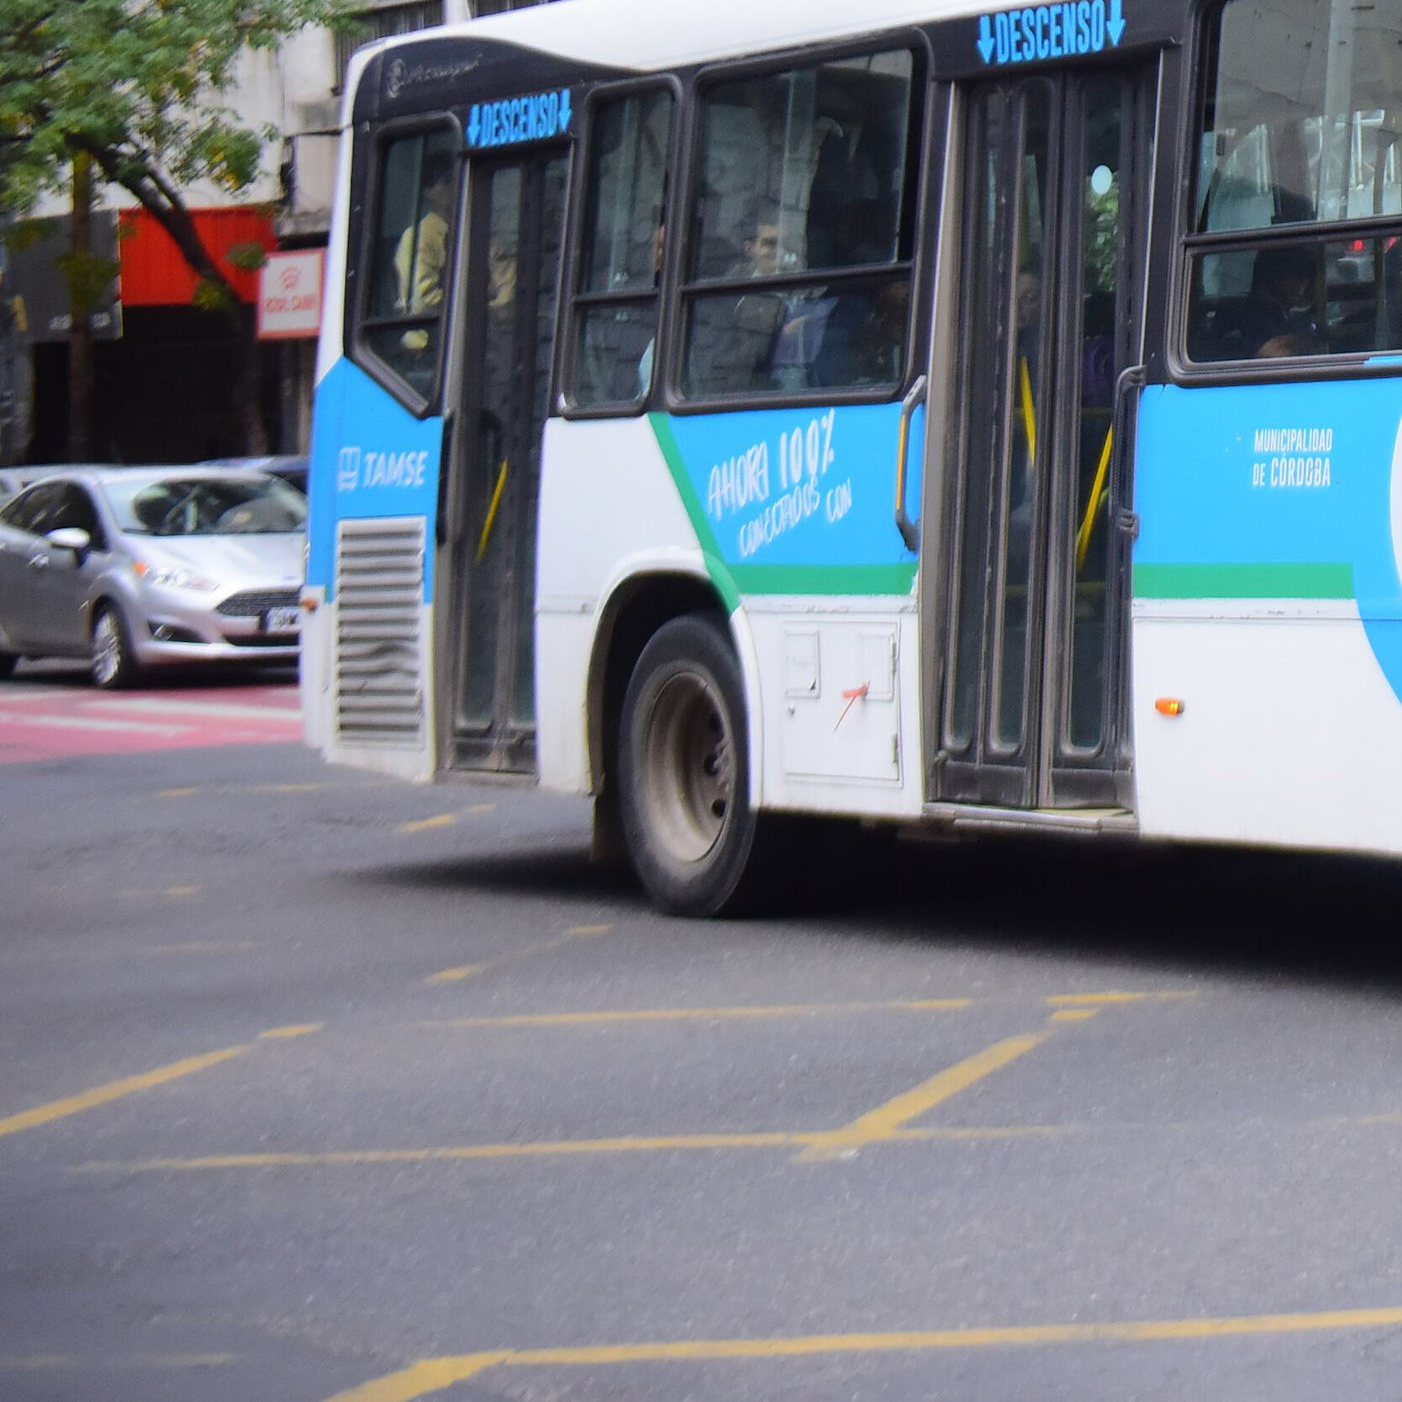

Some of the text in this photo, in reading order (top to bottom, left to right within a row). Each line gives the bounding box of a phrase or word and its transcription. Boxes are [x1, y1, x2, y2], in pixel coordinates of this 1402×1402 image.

[480, 92, 560, 148] DESCENSO
[1254, 428, 1334, 452] MUNICIPALIDAD
[362, 450, 430, 489] TAMSE
[708, 407, 836, 522] AHORA 100%
[1252, 453, 1331, 487] DE CÓRDOBA
[738, 473, 853, 559] CONECTADOS CON
